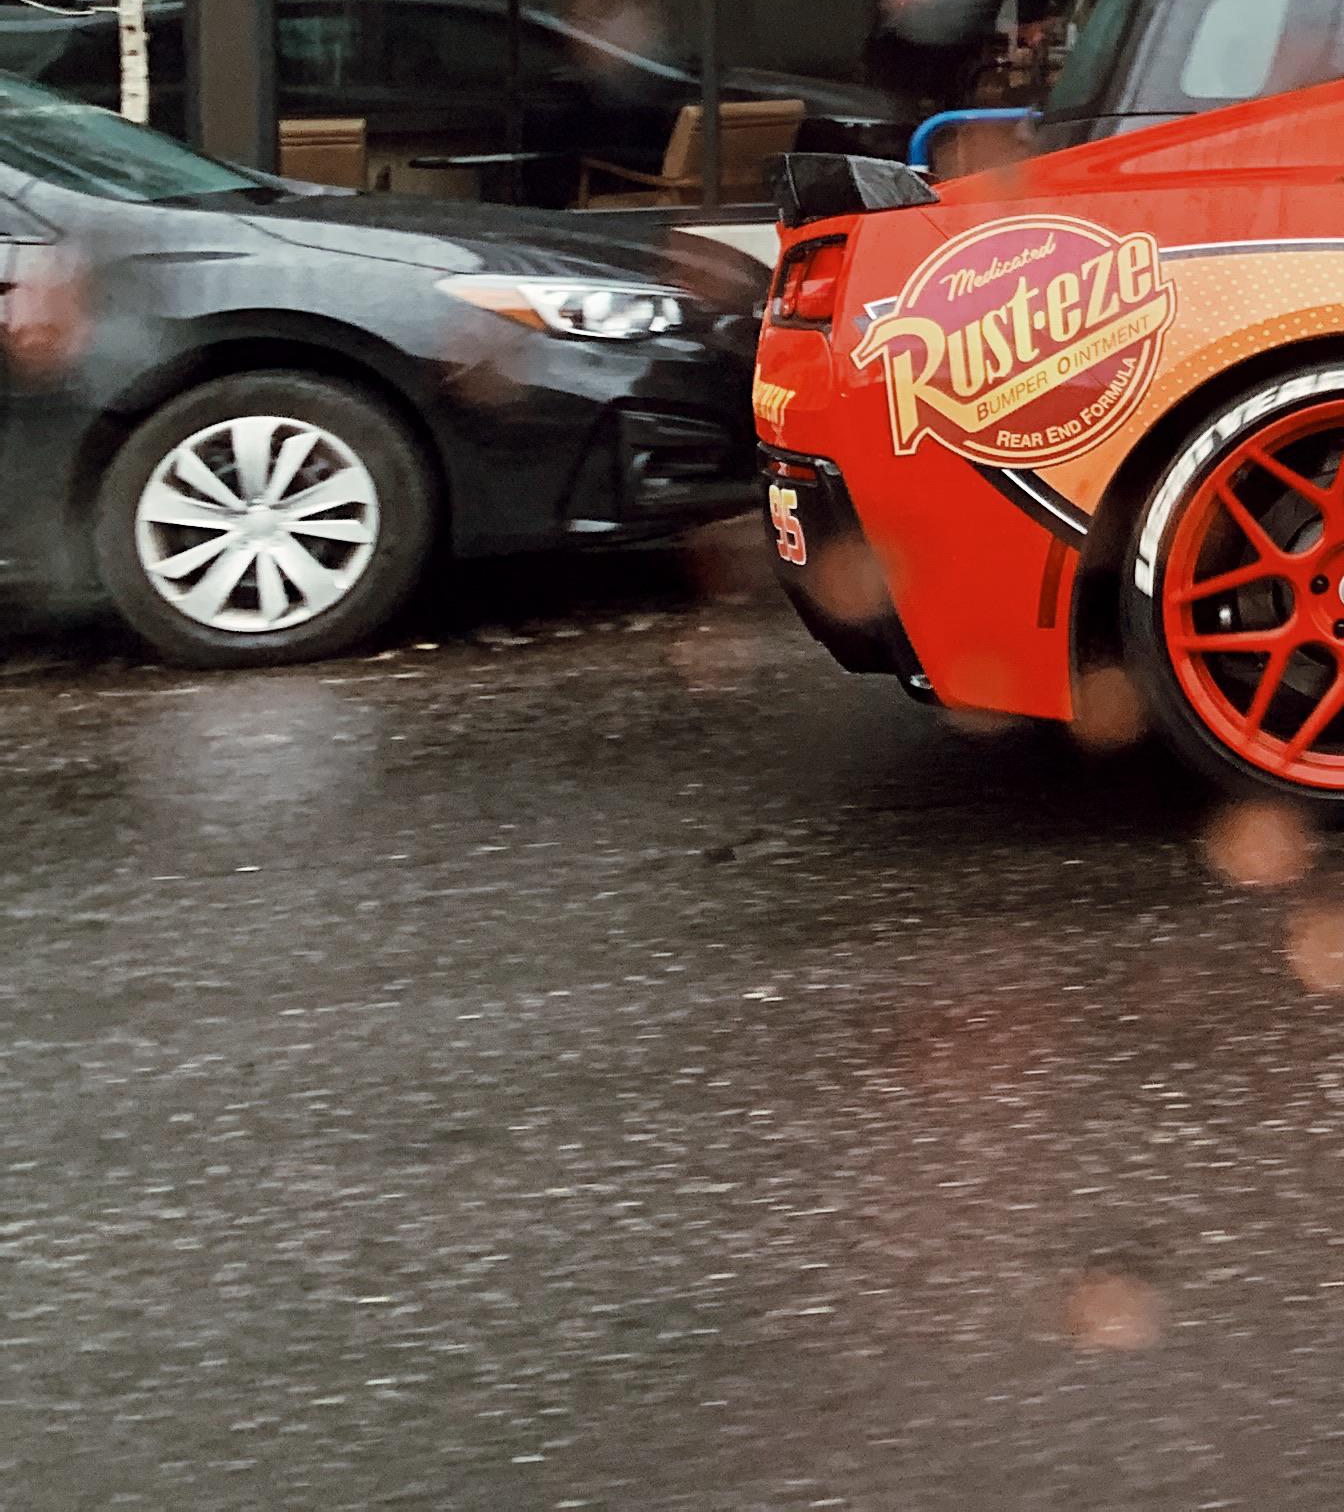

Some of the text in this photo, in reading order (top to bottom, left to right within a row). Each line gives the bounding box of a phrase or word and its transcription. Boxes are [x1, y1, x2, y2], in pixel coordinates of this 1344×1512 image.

[940, 232, 1057, 301] Medicated
[977, 315, 1150, 422] BUMPER OINTMENT
[997, 356, 1138, 448] REAR END FORMULA
[769, 484, 807, 566] 95
